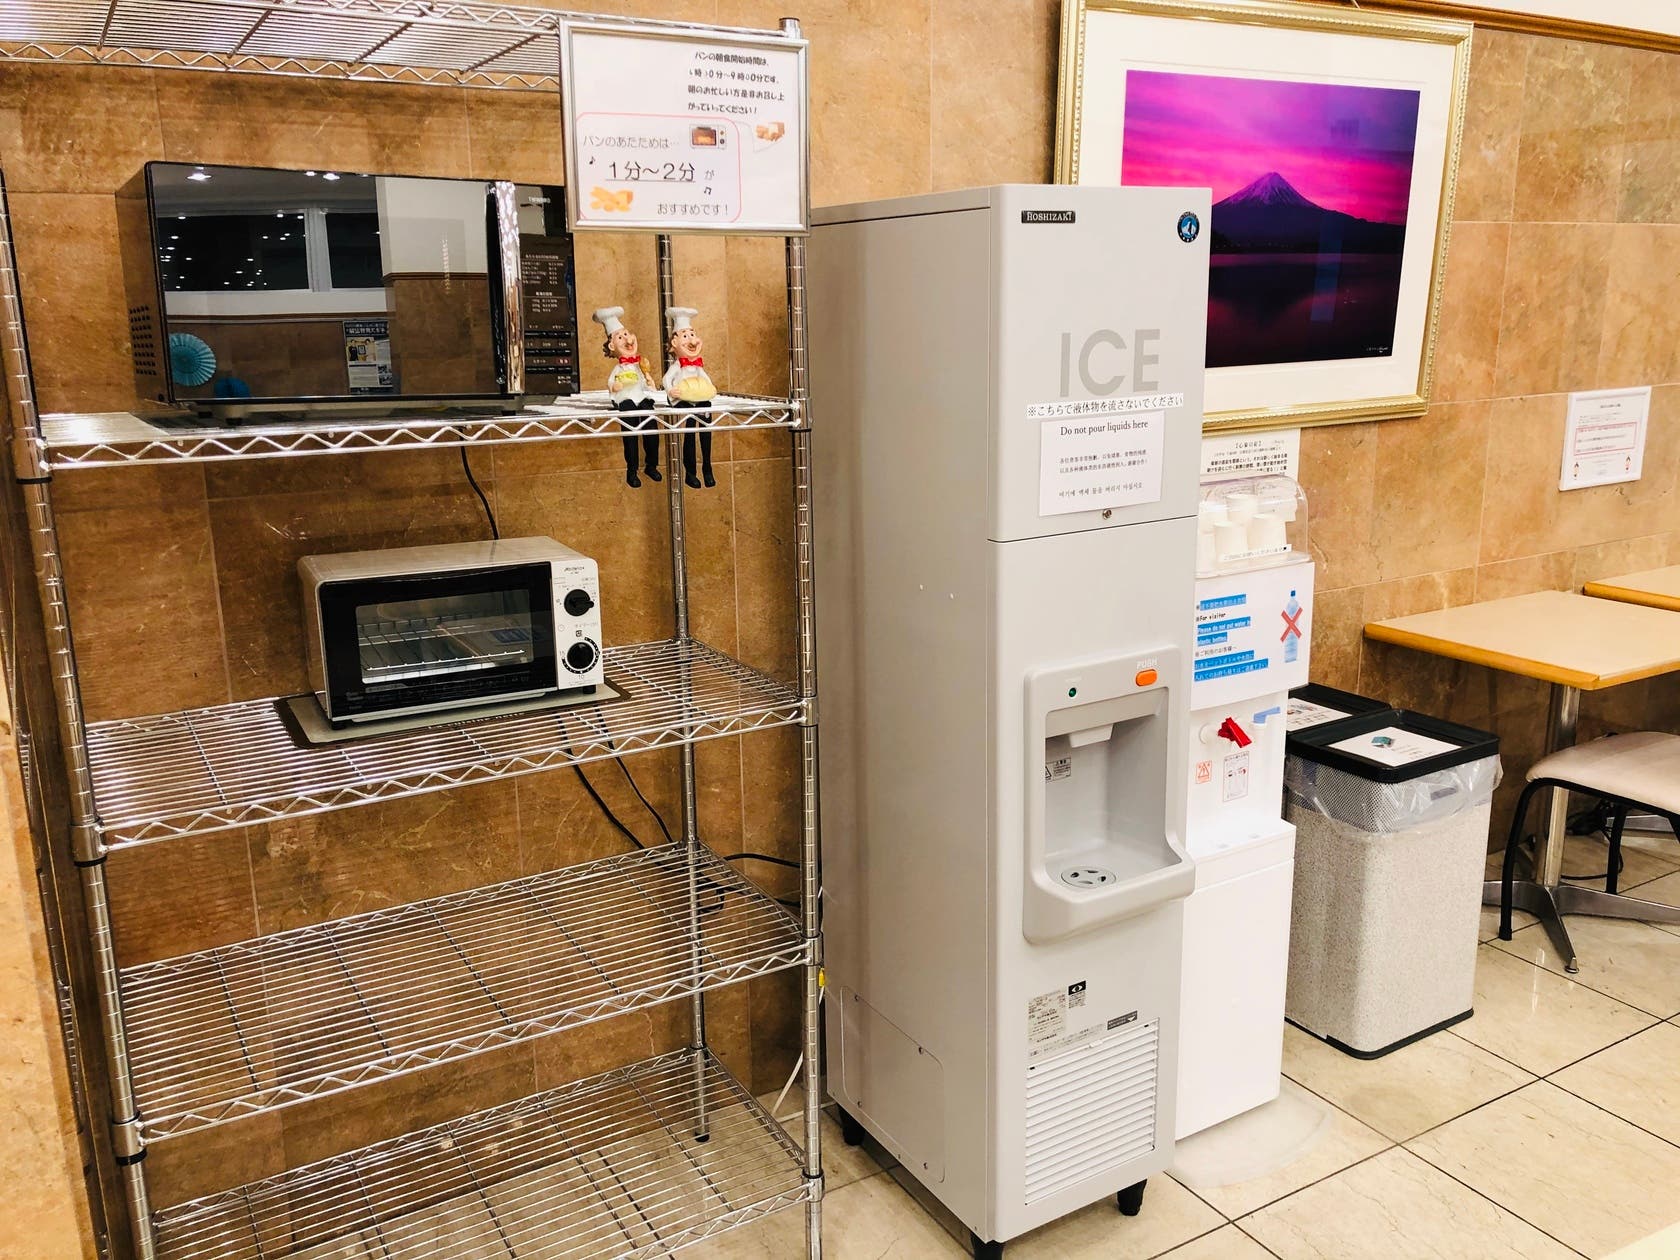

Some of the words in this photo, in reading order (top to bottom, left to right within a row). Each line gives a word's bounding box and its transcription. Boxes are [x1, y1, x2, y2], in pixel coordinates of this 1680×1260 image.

[704, 169, 715, 180] が
[1026, 211, 1073, 221] HOSHIZAKI
[1060, 329, 1160, 397] ICE
[1060, 427, 1072, 435] Do
[1074, 426, 1087, 434] not
[1088, 424, 1106, 435] pour
[1107, 421, 1131, 433] liquids
[1132, 419, 1149, 428] here
[1209, 612, 1226, 620] visitor
